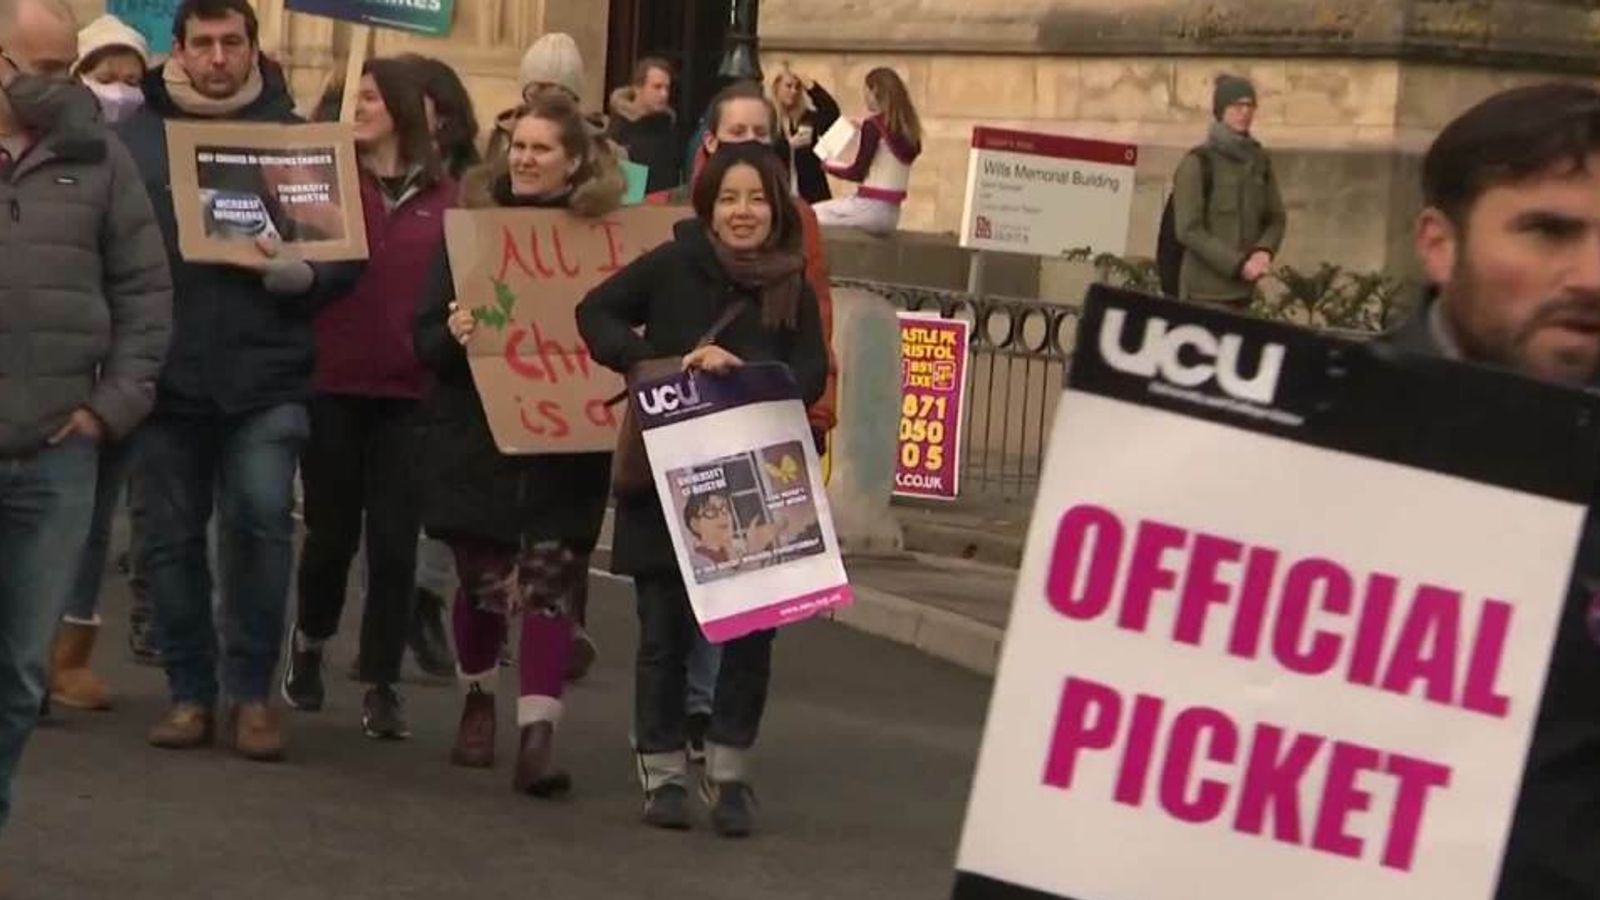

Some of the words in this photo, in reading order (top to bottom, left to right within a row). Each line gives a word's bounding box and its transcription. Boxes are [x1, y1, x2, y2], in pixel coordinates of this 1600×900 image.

[984, 158, 1011, 176] Wills
[1014, 164, 1070, 186] Memorial
[1072, 171, 1121, 193] Building
[1044, 504, 1514, 719] OFFICIAL
[1040, 675, 1454, 873] PICKET
